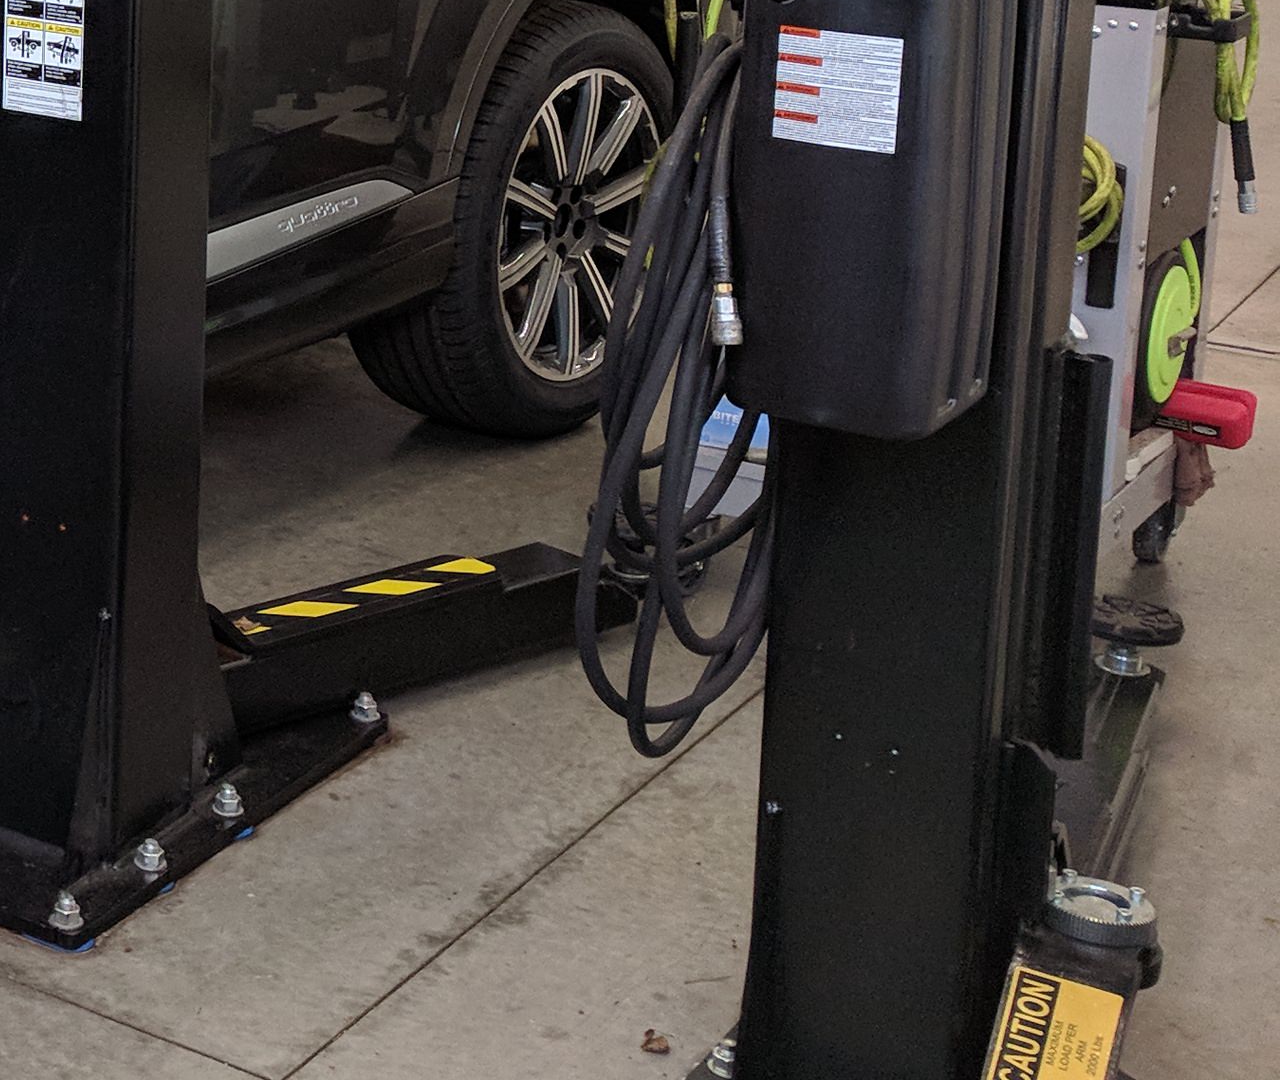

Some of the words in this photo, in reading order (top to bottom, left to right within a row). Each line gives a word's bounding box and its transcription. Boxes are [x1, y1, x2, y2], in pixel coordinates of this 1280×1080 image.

[16, 20, 41, 29] CAUTION
[54, 26, 80, 34] CAUTION
[277, 196, 359, 233] quattro
[1045, 1021, 1064, 1066] MAXIMUM
[1058, 1043, 1073, 1071] LOAD
[1067, 1023, 1078, 1044] PER
[1077, 1040, 1088, 1063] ARM
[1086, 1053, 1100, 1077] 2000
